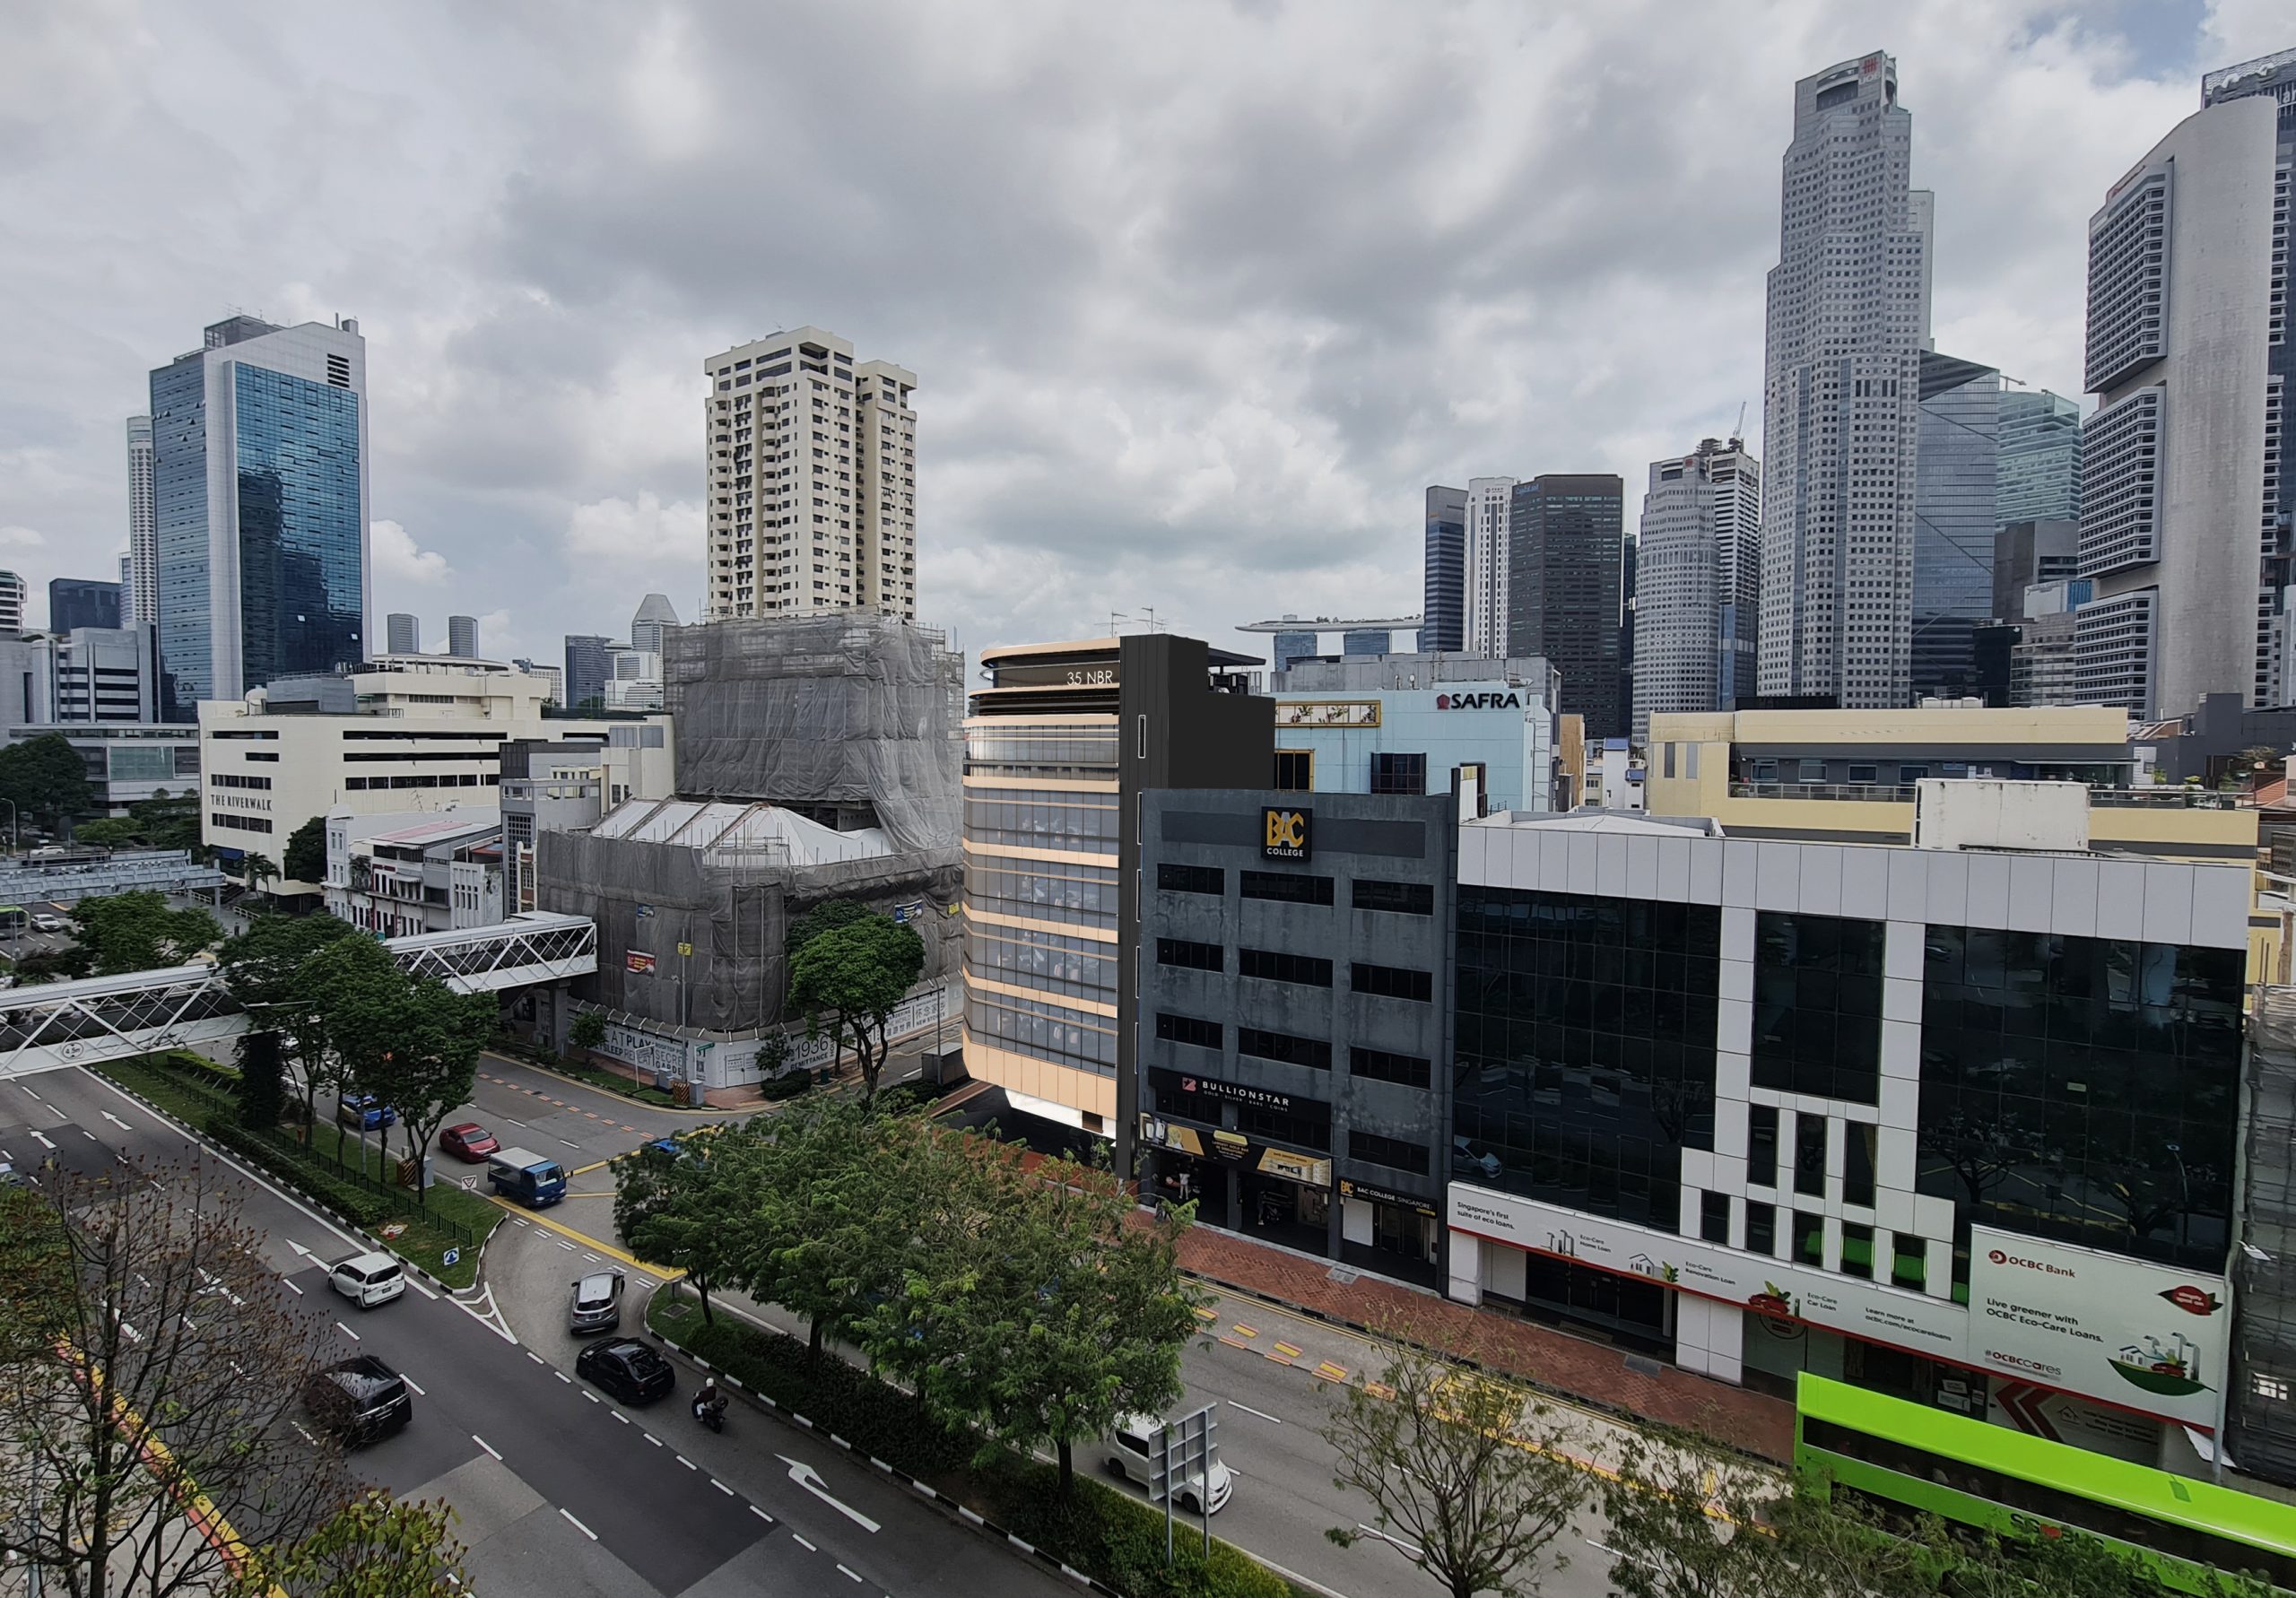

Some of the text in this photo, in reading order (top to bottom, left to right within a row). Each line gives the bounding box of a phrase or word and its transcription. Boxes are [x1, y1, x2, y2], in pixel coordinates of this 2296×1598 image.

[1067, 670, 1113, 686] 35 NBR
[1451, 693, 1520, 709] SAFRA
[211, 795, 273, 812] THE RIVERWALK
[1266, 847, 1304, 857] COLLEGE
[626, 1034, 651, 1049] PLAY
[795, 1035, 829, 1059] 1936
[604, 1044, 623, 1056] SLEEP
[655, 1049, 683, 1067] SECRE
[655, 1061, 683, 1076] GARDE
[1203, 1081, 1290, 1107] BULLIONSTAR
[1269, 1104, 1289, 1113] COINS
[1357, 1186, 1369, 1194] BAC
[1370, 1190, 1396, 1202] COLLEGE
[1457, 1202, 1509, 1220] Singapore's first
[1457, 1211, 1473, 1219] suite
[1495, 1220, 1515, 1229] loans.
[2008, 1256, 2076, 1279] OCBC Bank
[1720, 1277, 1736, 1285] Loan
[1807, 1292, 1838, 1305] Eco-Care
[1820, 1303, 1837, 1311] Loan
[1866, 1307, 1885, 1316] Learn
[1886, 1313, 1906, 1322] more
[1987, 1298, 2079, 1326] Live greener with
[1986, 1307, 2104, 1343] OCBC Eco-Care Loans.
